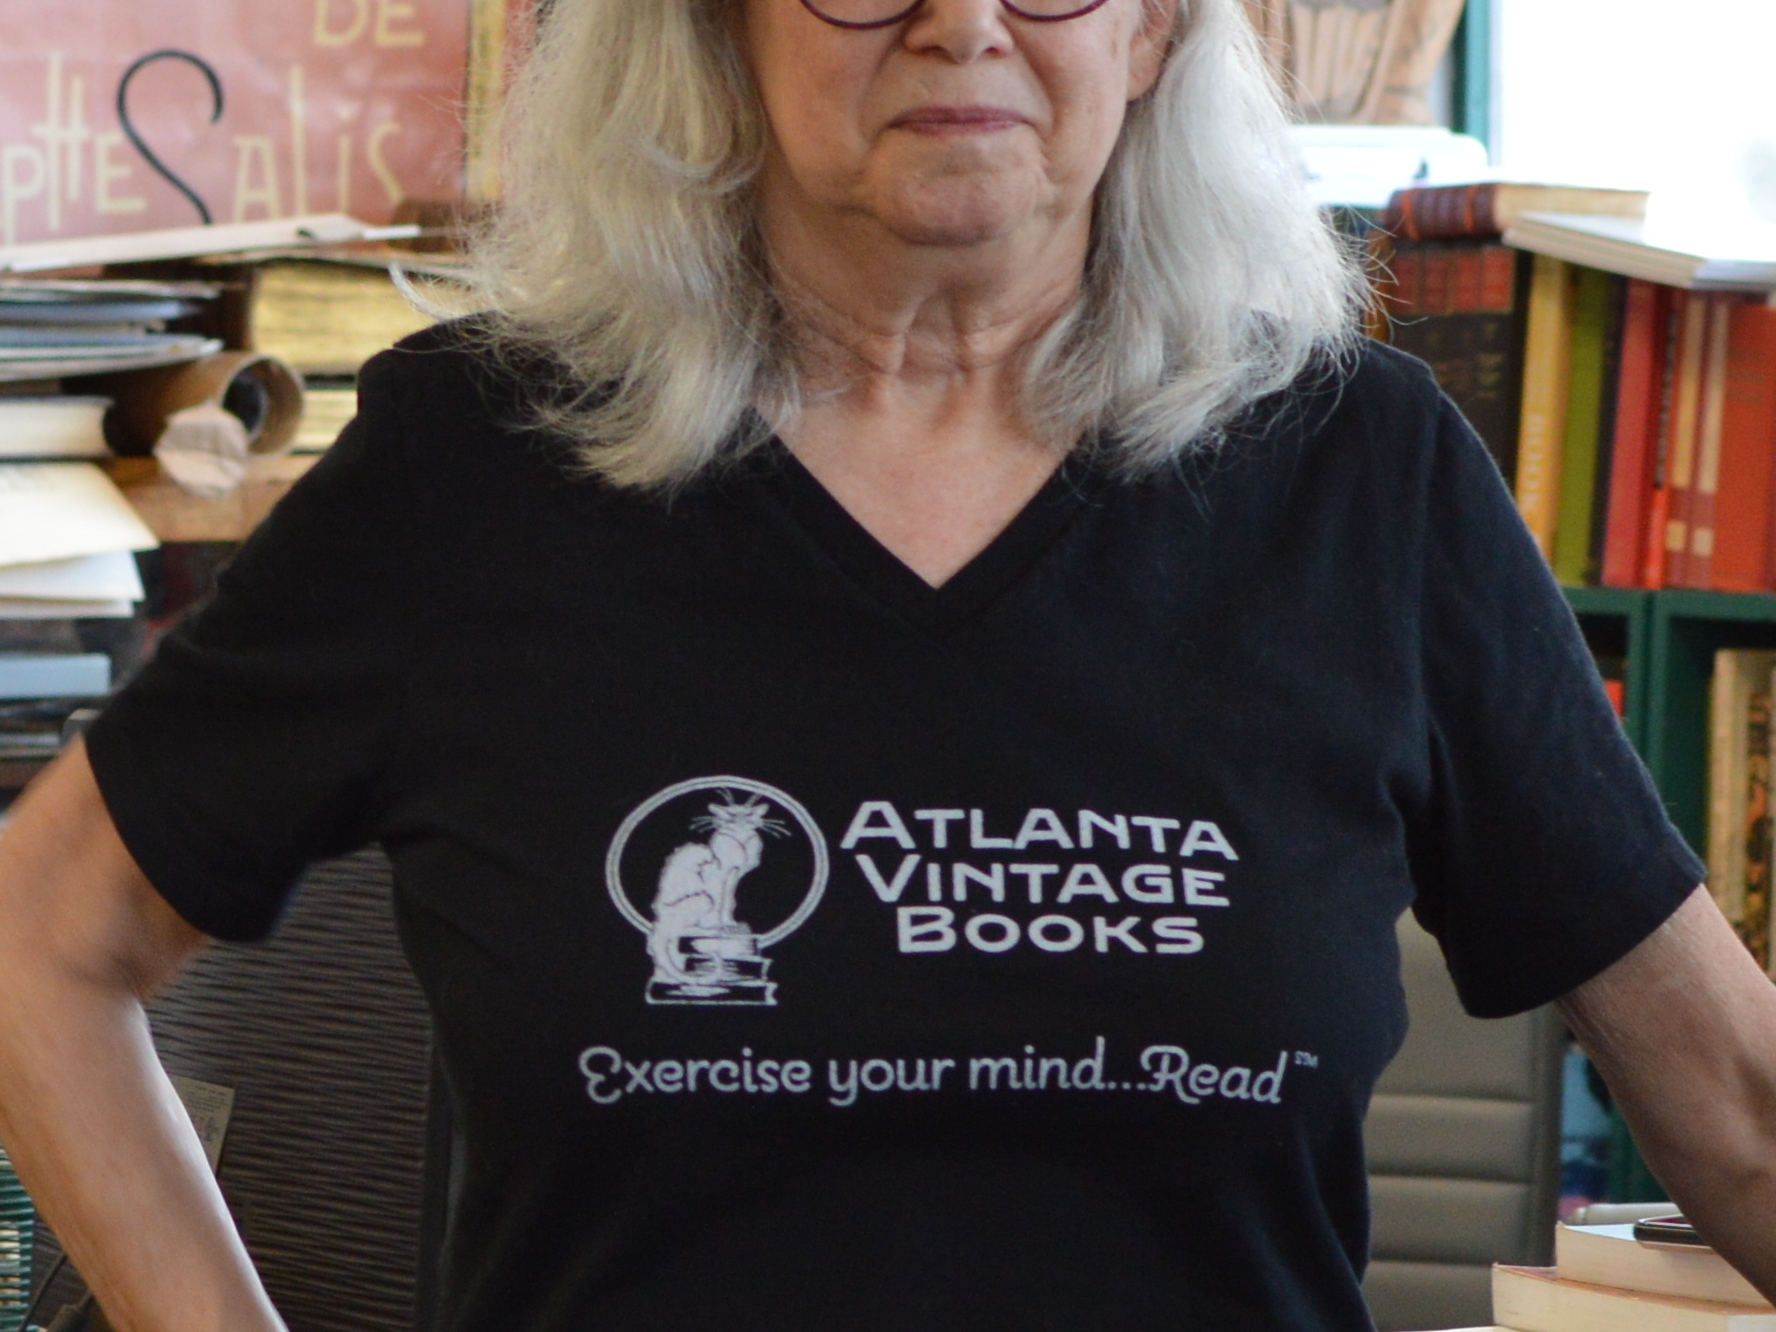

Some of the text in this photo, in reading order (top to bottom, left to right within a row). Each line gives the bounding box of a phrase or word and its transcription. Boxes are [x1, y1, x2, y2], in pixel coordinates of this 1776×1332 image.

[840, 800, 1239, 861] ATLANTA
[855, 854, 1230, 907] VINTAGE
[896, 906, 1205, 955] BOOKS
[578, 1046, 811, 1105] Exercise
[828, 1057, 956, 1106] your
